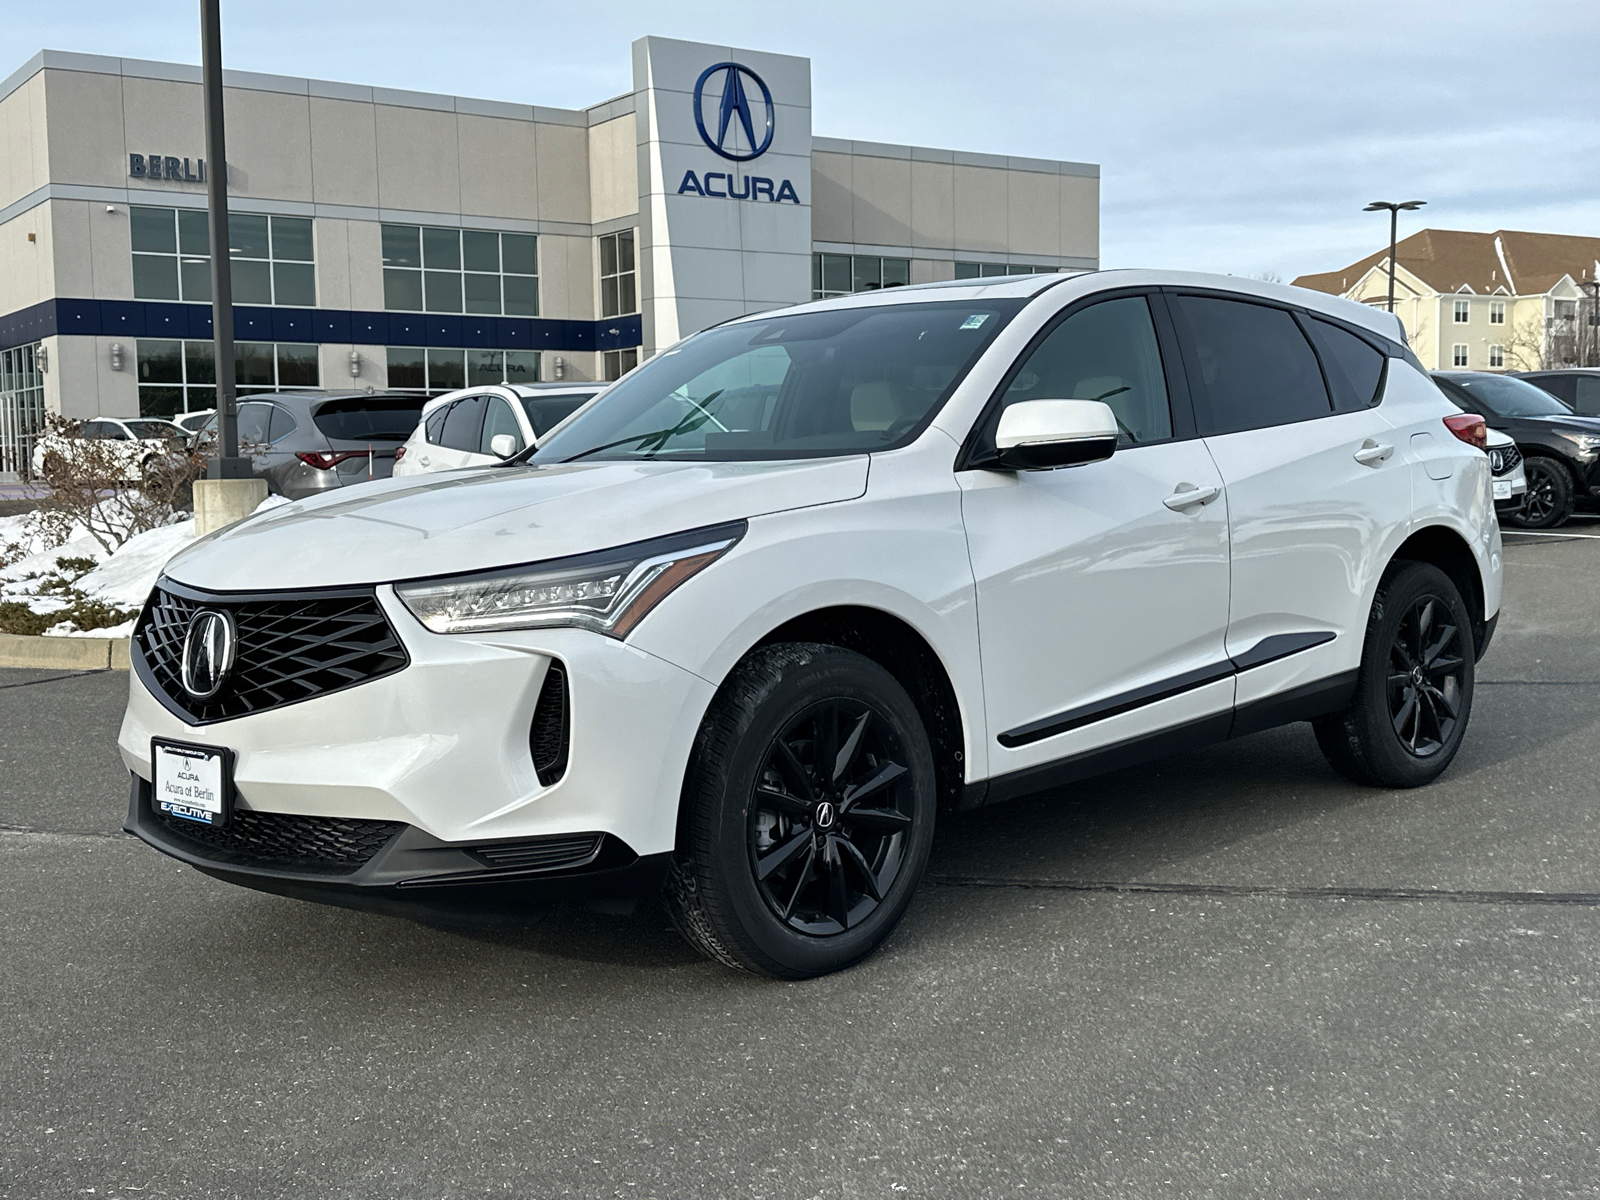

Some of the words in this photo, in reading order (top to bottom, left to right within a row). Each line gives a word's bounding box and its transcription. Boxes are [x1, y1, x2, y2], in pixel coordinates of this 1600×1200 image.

[129, 153, 228, 184] BERLI
[677, 170, 801, 204] ACURA
[177, 772, 200, 782] ACURA
[165, 781, 184, 795] Acura
[185, 786, 193, 797] of
[194, 786, 214, 801] Berlin
[161, 802, 212, 820] EXECUTIVE
